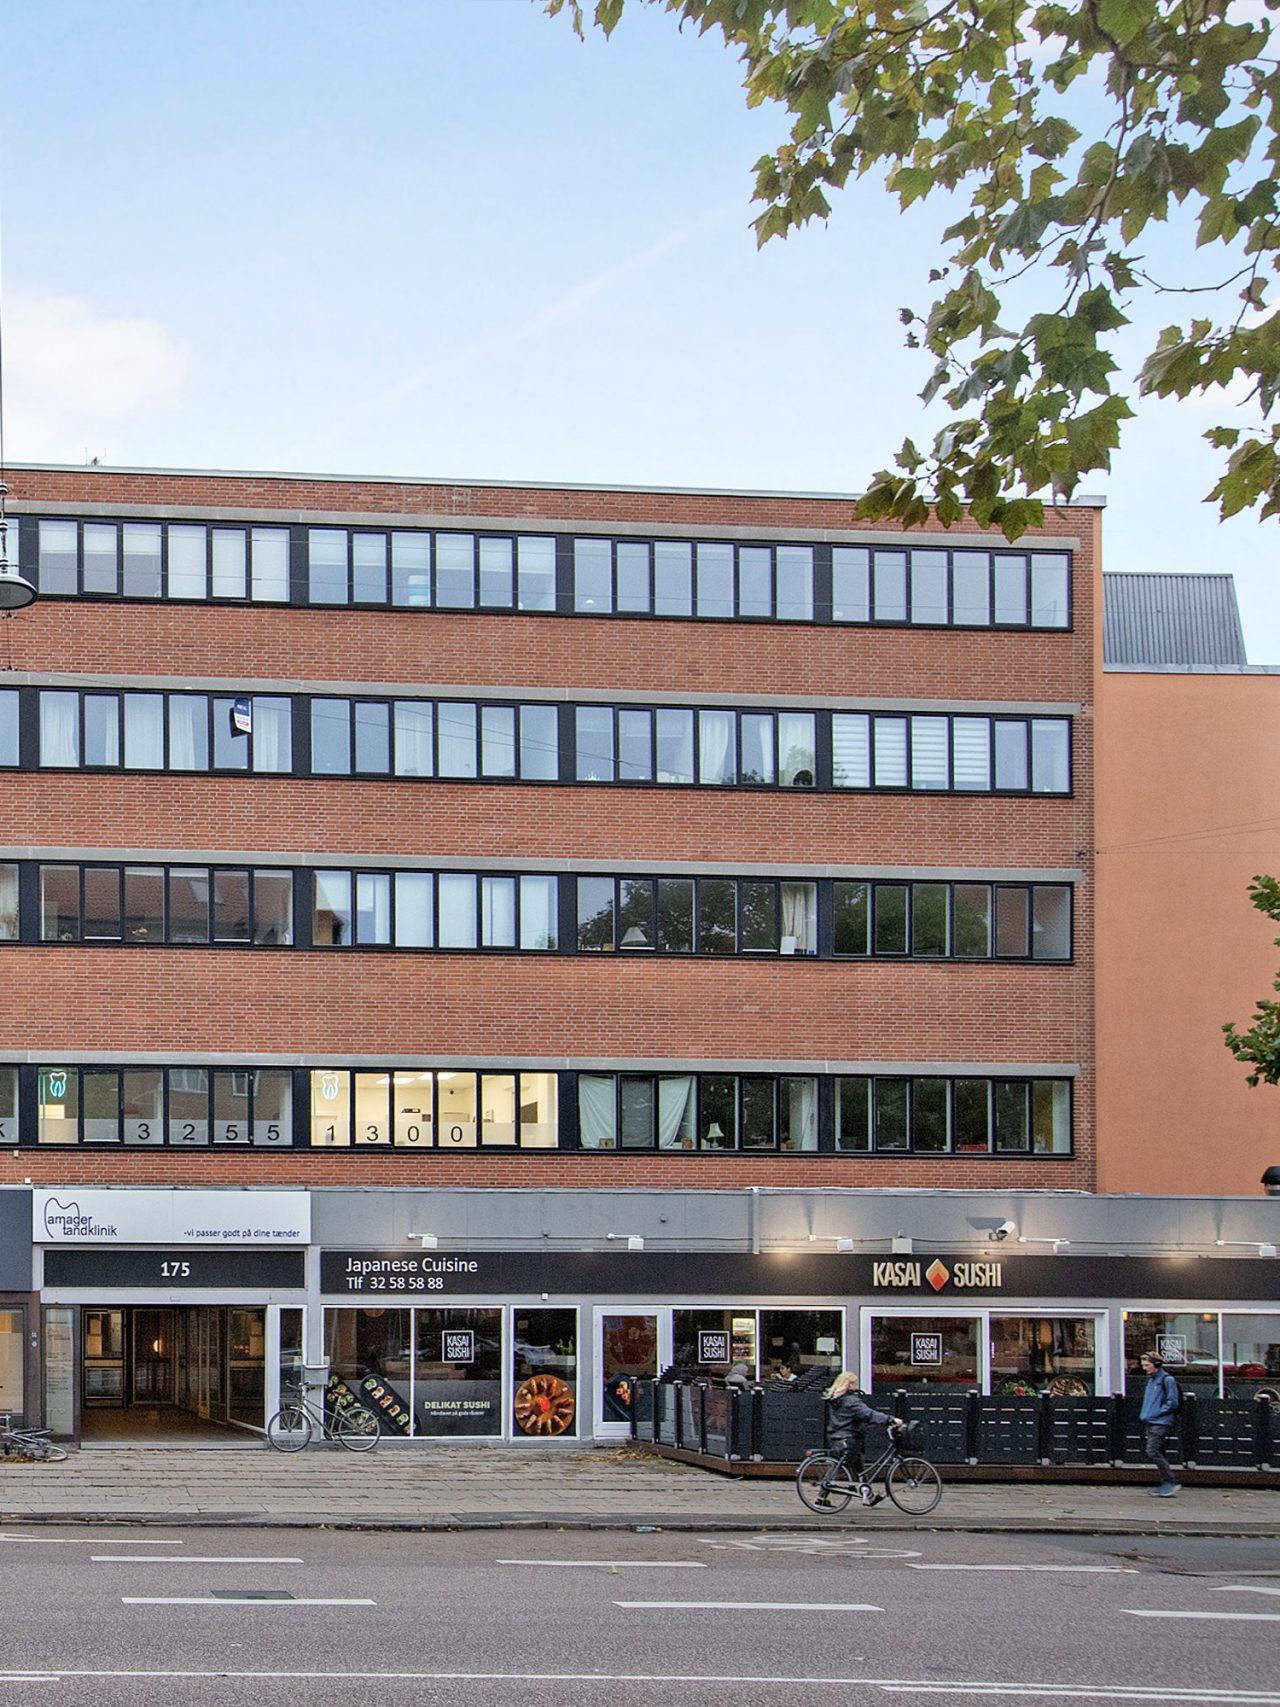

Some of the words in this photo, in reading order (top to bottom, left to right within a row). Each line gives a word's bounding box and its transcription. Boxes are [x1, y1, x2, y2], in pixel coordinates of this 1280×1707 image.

[47, 1215, 93, 1228] amager
[63, 1225, 118, 1237] tandklinik
[196, 1229, 221, 1237] passer
[222, 1229, 240, 1239] godt
[242, 1228, 251, 1239] på
[253, 1229, 271, 1237] dine
[160, 1261, 191, 1277] 175
[346, 1257, 418, 1275] Japanese
[421, 1257, 478, 1272] Cuisine
[873, 1262, 921, 1287] KASAI
[953, 1262, 1002, 1288] SUSHI
[346, 1276, 363, 1289] Tlf
[370, 1277, 386, 1289] 32
[389, 1277, 405, 1289] 58
[408, 1277, 425, 1289] 58
[427, 1277, 444, 1289] 88
[447, 1335, 469, 1347] KASAI
[703, 1336, 725, 1347] KASAI
[915, 1338, 937, 1348] KASAI
[447, 1347, 470, 1358] SUSHI
[703, 1347, 725, 1359] SUSHI
[915, 1349, 938, 1360] SUSHI
[424, 1401, 462, 1409] DELIKAT
[463, 1401, 490, 1409] SUSHI
